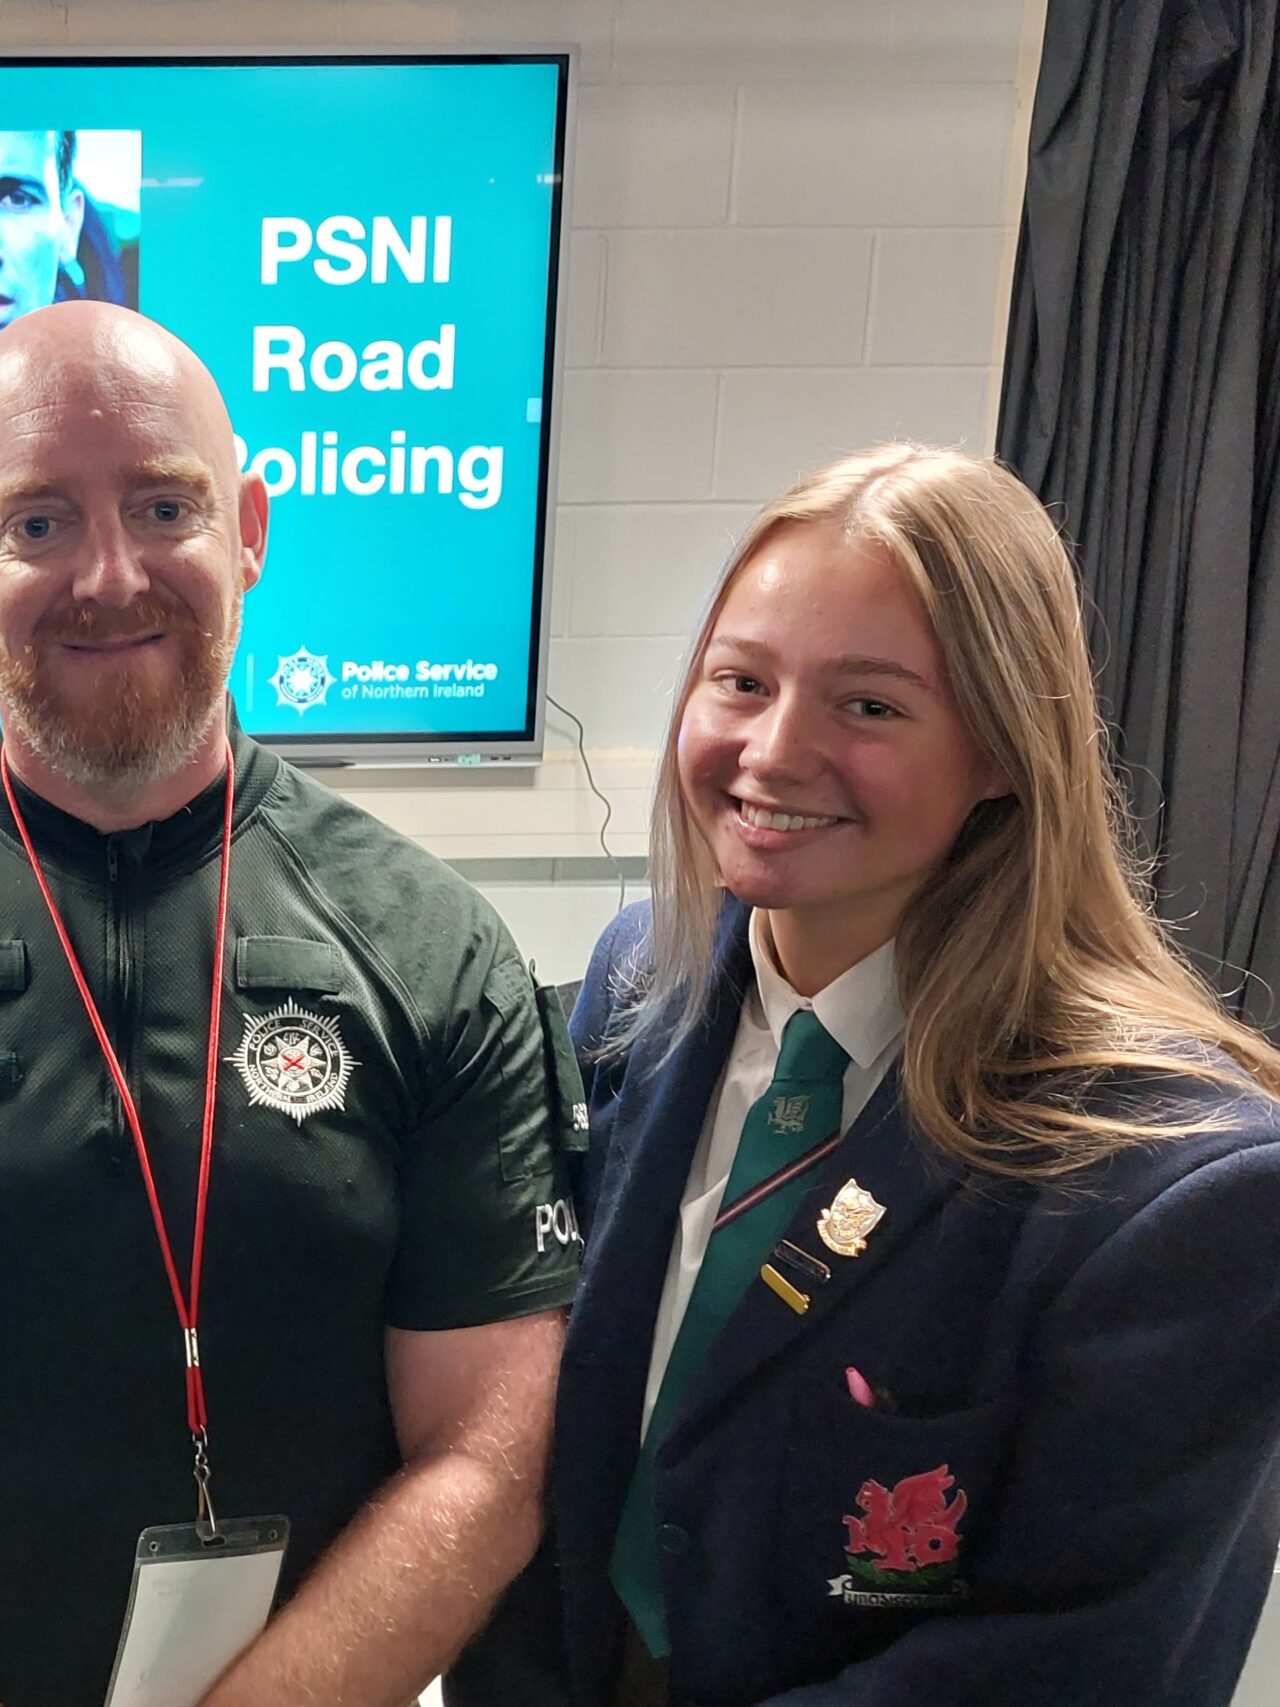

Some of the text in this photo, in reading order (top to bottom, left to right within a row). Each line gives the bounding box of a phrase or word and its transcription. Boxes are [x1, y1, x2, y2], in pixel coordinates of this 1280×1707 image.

[260, 215, 452, 285] PSNI
[252, 323, 456, 392] Road
[341, 660, 410, 682] Police
[415, 659, 499, 681] Service
[342, 682, 486, 698] of Northern Ireland
[249, 1020, 339, 1057] POLICE SERVICE
